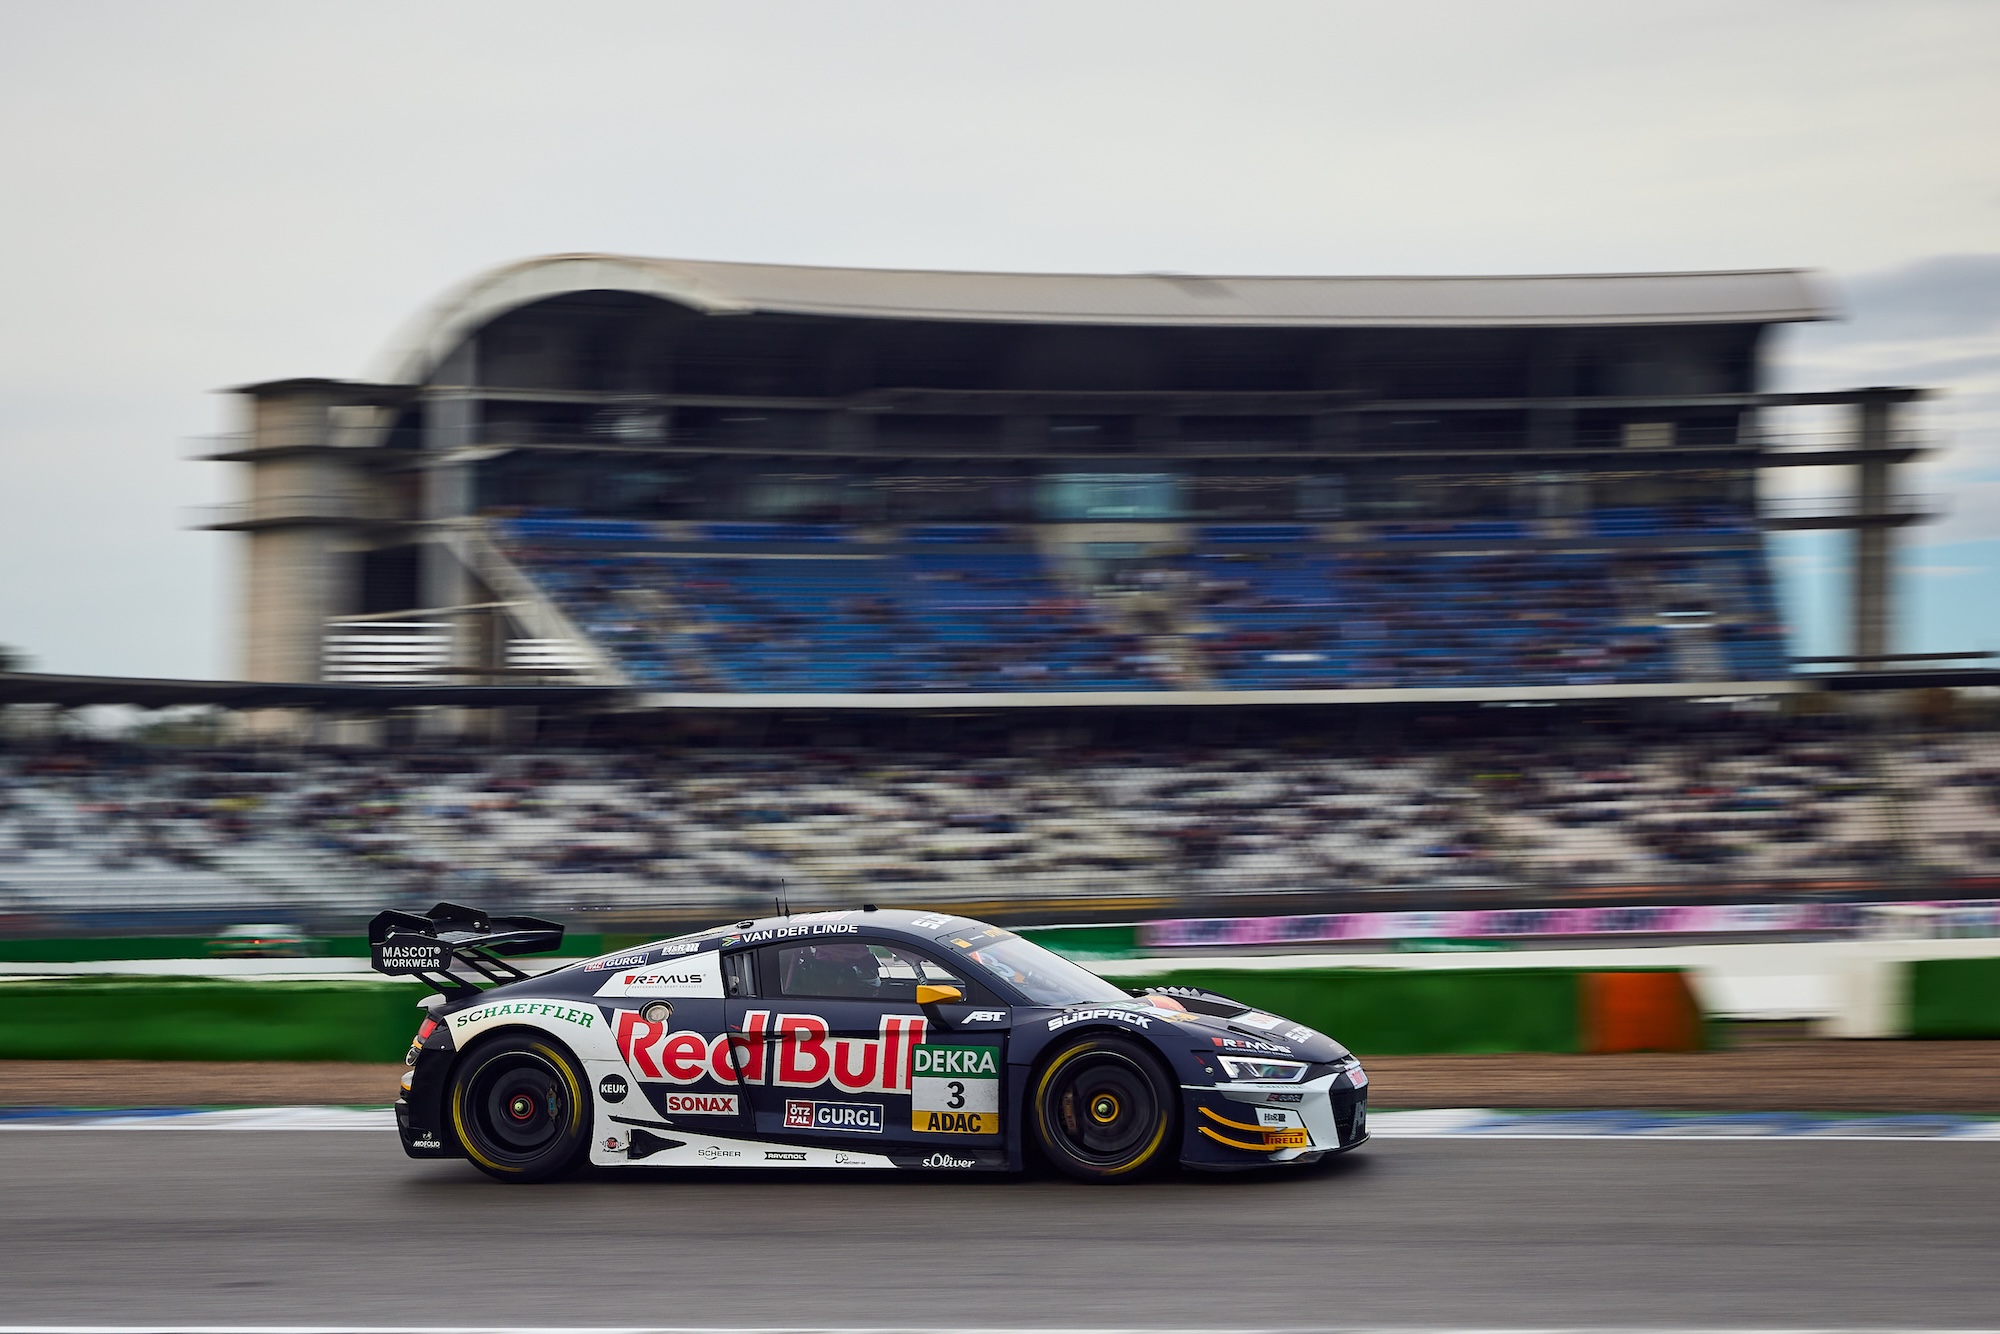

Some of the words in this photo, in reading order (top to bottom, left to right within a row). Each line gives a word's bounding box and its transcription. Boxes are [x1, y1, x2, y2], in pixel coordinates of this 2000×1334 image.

[743, 929, 773, 943] VAN
[777, 925, 809, 938] DER
[813, 924, 859, 934] LINDE
[383, 959, 441, 968] WORKWEAR
[605, 956, 645, 967] GURGL
[633, 974, 703, 984] REMUS
[457, 1003, 595, 1028] SCHAEFFLER
[961, 1010, 1006, 1024] ABT
[614, 1011, 766, 1082] Red
[779, 1016, 925, 1090] Bull
[914, 1049, 997, 1073] DEKRA
[601, 1084, 626, 1094] KEUK
[946, 1081, 966, 1109] 3
[668, 1096, 734, 1112] SONAX
[790, 1104, 811, 1116] ÖTZ
[790, 1116, 810, 1124] TAL
[818, 1107, 880, 1127] GURGL
[927, 1112, 982, 1132] ADAC
[1264, 1131, 1304, 1145] PIRELLI
[698, 1149, 741, 1157] SCHERER
[922, 1153, 976, 1168] s.Oliver
